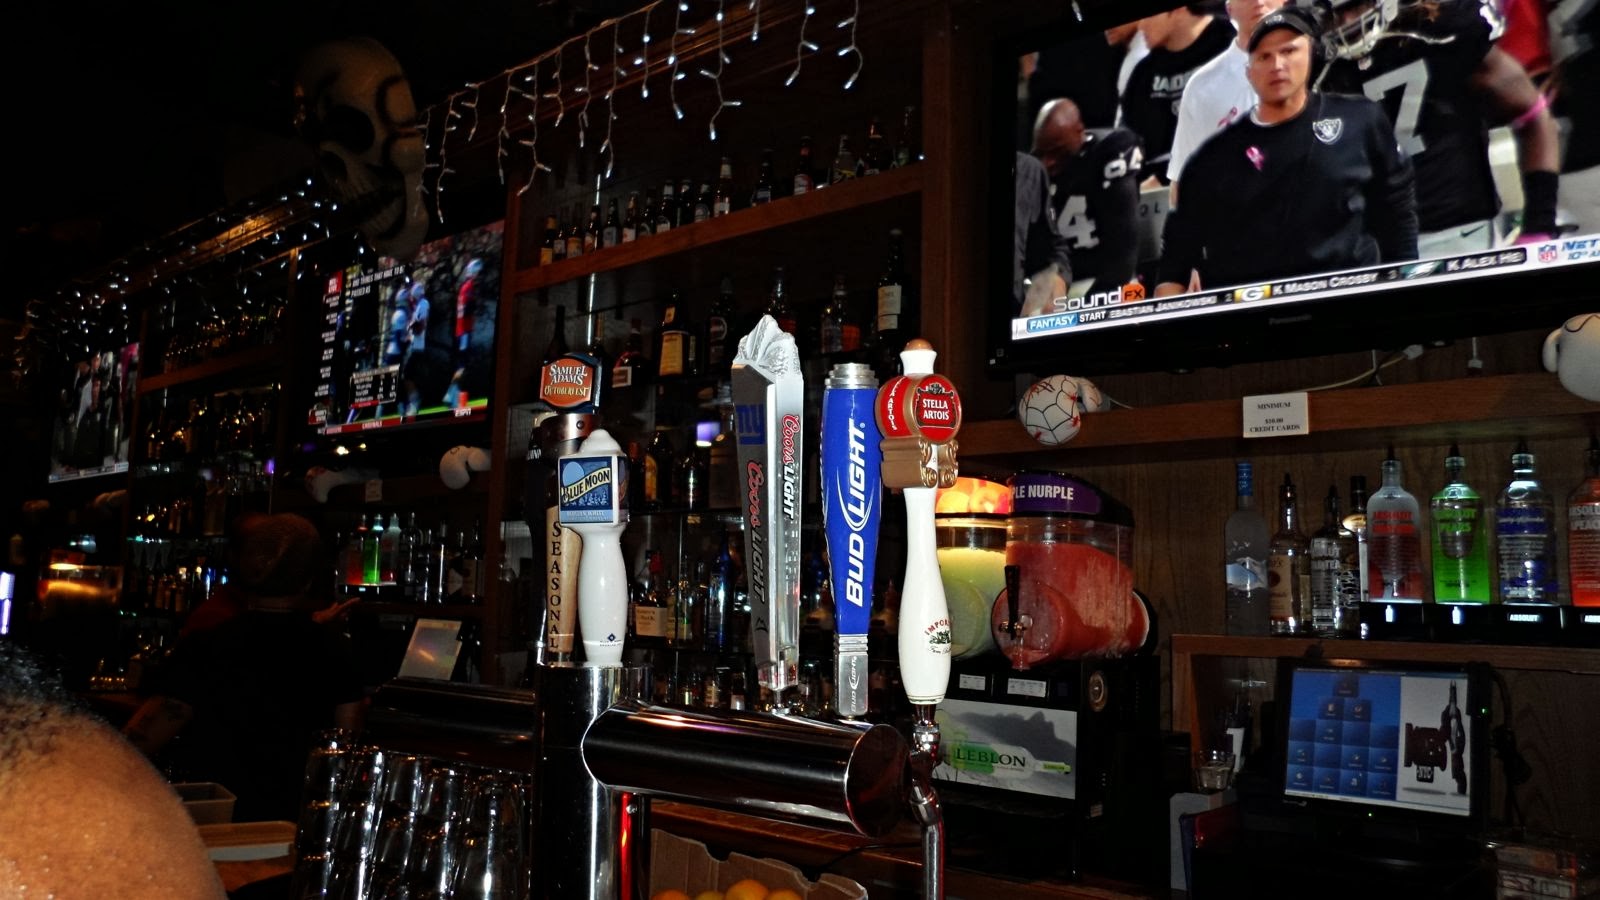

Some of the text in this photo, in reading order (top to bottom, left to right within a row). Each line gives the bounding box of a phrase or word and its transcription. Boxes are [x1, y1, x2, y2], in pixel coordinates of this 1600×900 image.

[1029, 315, 1075, 330] FANTASY
[1079, 311, 1106, 323] START
[1273, 284, 1284, 295] K
[549, 364, 588, 377] SAMUEL
[551, 374, 584, 385] ADAMS
[922, 398, 949, 409] STELLA
[1257, 402, 1291, 410] MINIMUM
[922, 409, 950, 421] ARTOIS
[782, 413, 801, 463] Coors
[1250, 425, 1275, 433] CREDIT
[560, 469, 610, 503] BLUE MOON
[782, 463, 796, 520] LIGHT
[1027, 484, 1075, 500] NURPLE
[846, 417, 866, 607] BUD LIGHT
[746, 459, 766, 605] Coors LIGHT
[550, 521, 562, 649] SEASONAL
[956, 747, 1027, 768] LEBLON
